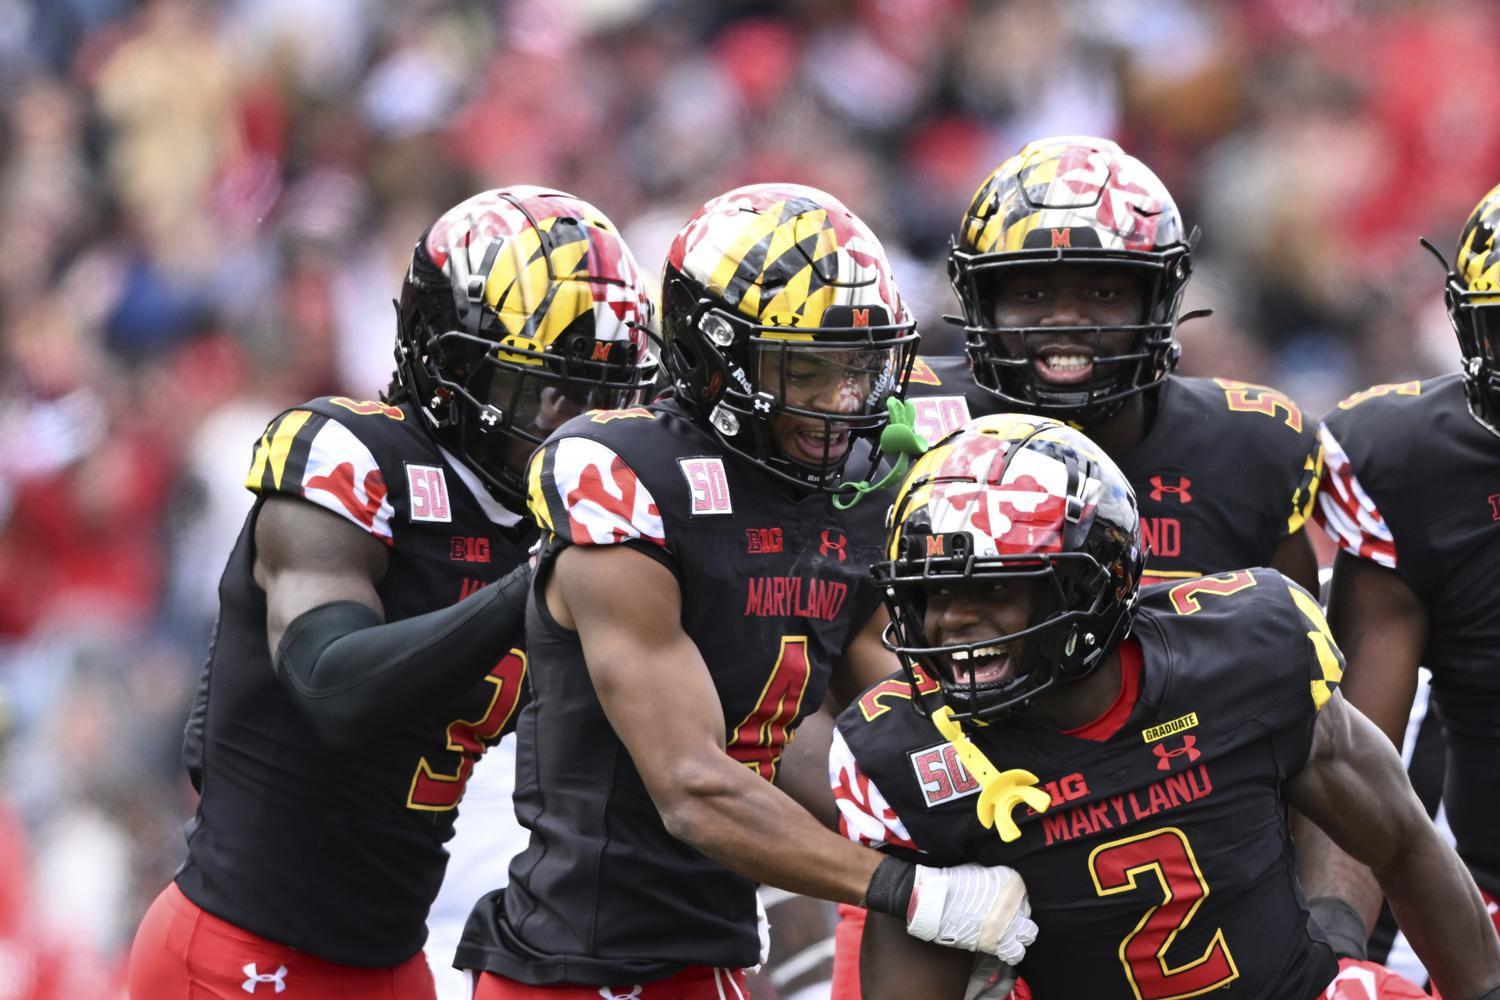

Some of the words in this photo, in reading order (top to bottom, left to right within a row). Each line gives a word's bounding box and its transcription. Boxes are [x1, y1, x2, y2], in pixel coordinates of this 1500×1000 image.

[409, 467, 448, 518] 50
[685, 461, 729, 511] 50
[744, 576, 847, 622] MARYLAND
[406, 647, 528, 812] 3
[726, 635, 811, 784] 4
[1145, 713, 1197, 742] GRADUATE
[915, 745, 979, 803] 50
[1041, 763, 1214, 847] MARYLAND
